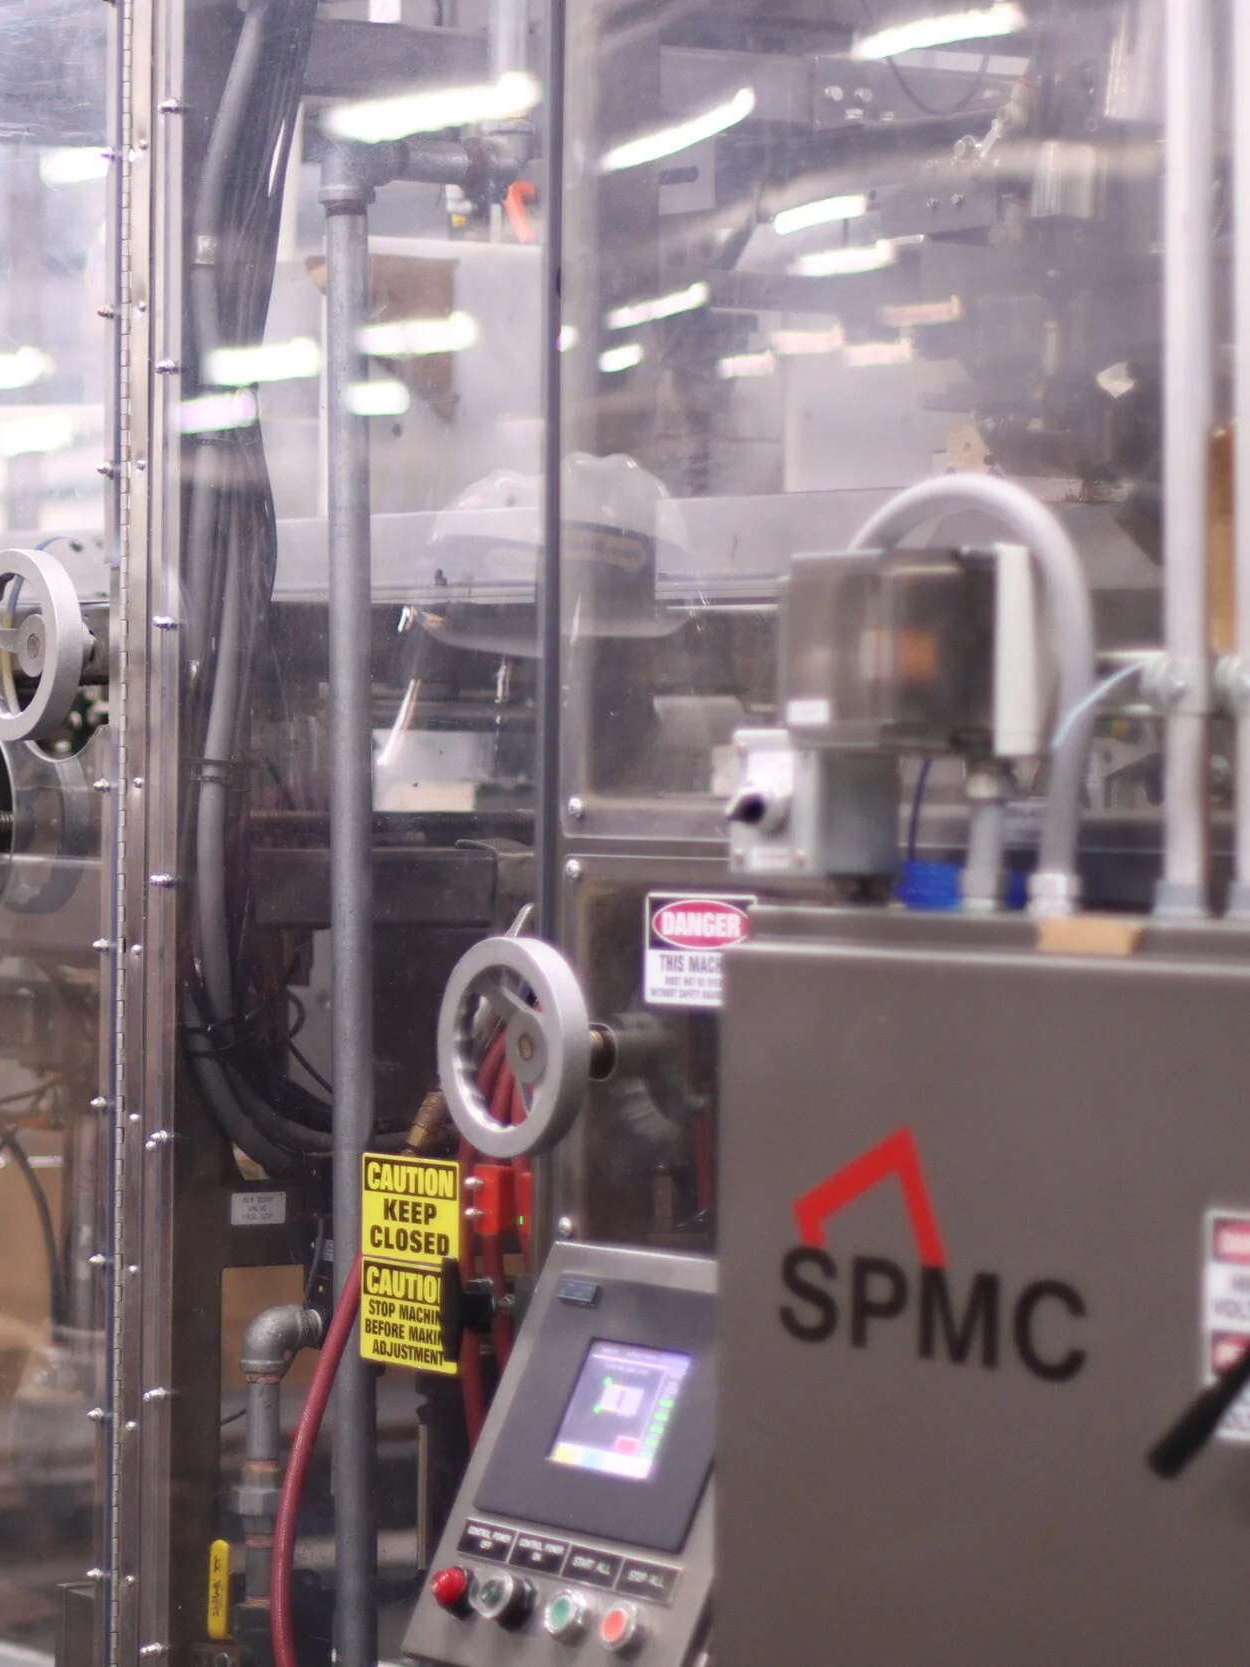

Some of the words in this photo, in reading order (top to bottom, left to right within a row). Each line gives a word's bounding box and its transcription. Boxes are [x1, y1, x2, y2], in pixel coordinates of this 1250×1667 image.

[661, 911, 741, 938] DANGER
[659, 954, 684, 972] THIS
[366, 1160, 454, 1198] CAUTION
[383, 1197, 437, 1226] KEEP
[370, 1224, 450, 1257] CLOSED
[368, 1298, 396, 1318] STOP
[779, 1246, 1087, 1383] SPMC
[365, 1317, 405, 1340] BEFORE
[372, 1338, 444, 1366] ADJUSTMENT
[572, 1555, 595, 1570] START
[596, 1562, 611, 1576] ALL
[626, 1569, 647, 1585] STOP
[648, 1573, 665, 1588] ALL
